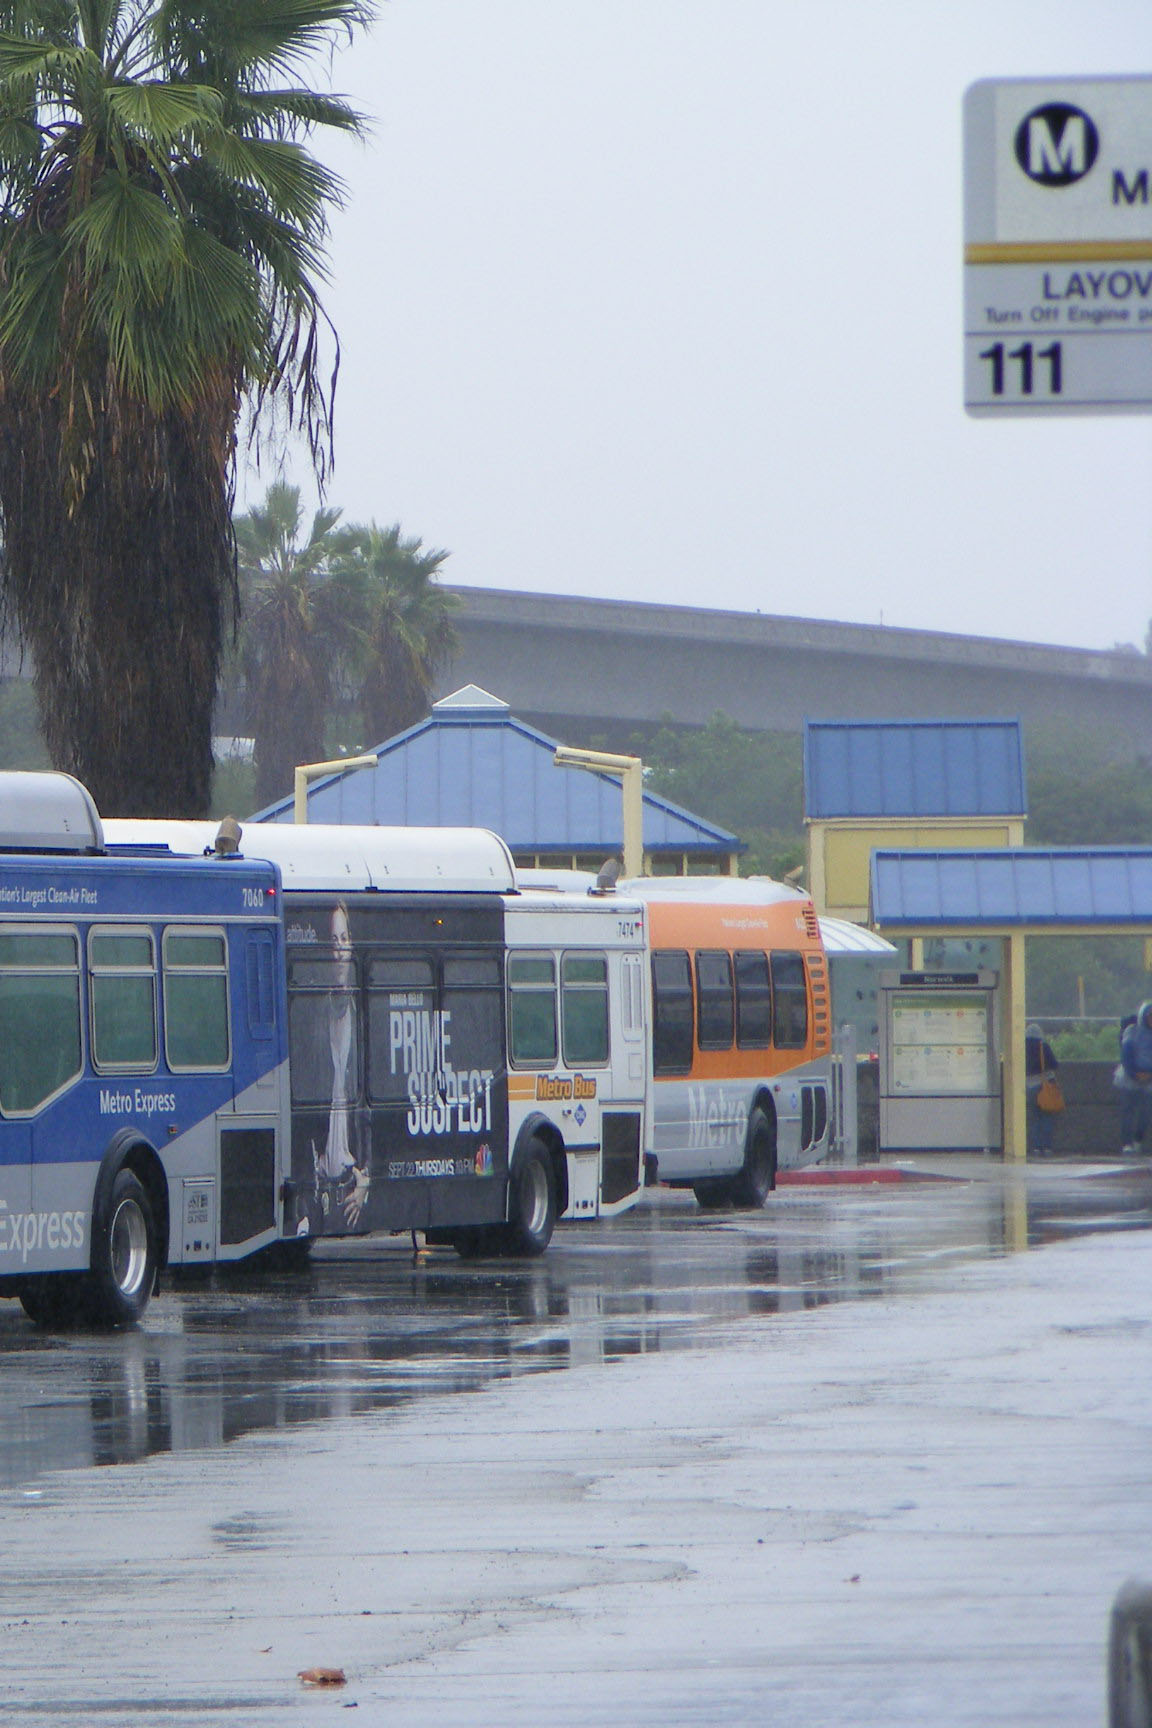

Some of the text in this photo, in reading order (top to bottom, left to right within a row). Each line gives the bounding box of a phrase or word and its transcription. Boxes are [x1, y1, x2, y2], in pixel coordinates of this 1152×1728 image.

[1026, 114, 1088, 176] M
[1112, 168, 1152, 205] M
[1042, 270, 1152, 300] LAYOV
[986, 306, 1023, 323] Turn
[1030, 305, 1059, 322] Off
[1067, 304, 1129, 325] Engine
[979, 341, 1062, 395] 111
[21, 886, 47, 908] Largest
[48, 887, 80, 904] Clean-Air
[81, 888, 97, 904] Fleet
[242, 888, 263, 907] 7060
[389, 1010, 452, 1075] PRIME
[99, 1088, 176, 1117] Metro Express
[407, 1069, 494, 1136] SUSPECT
[536, 1073, 596, 1101] Metro Bus
[688, 1087, 747, 1147] Metro
